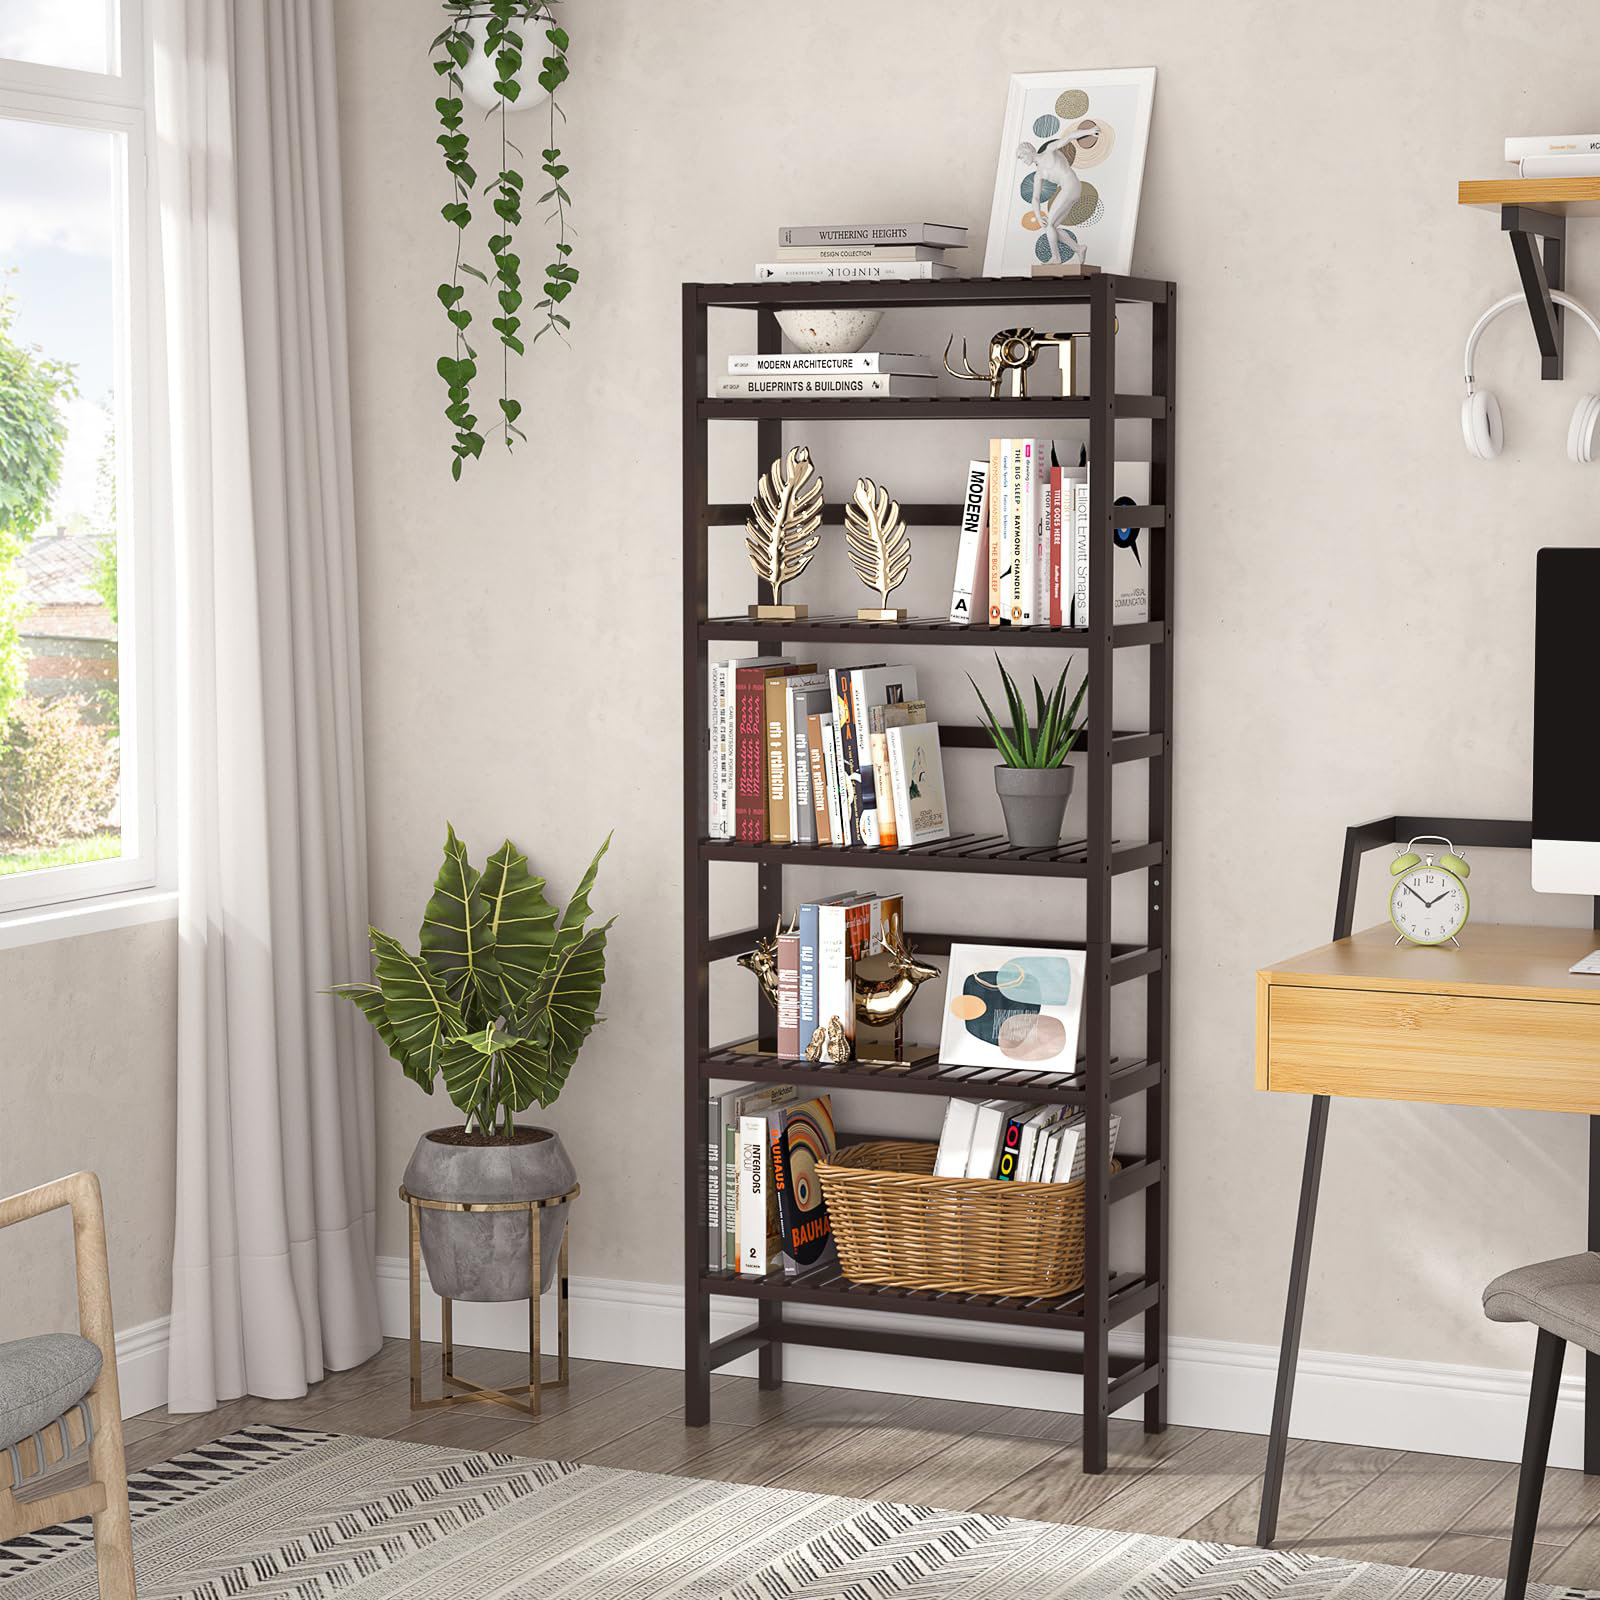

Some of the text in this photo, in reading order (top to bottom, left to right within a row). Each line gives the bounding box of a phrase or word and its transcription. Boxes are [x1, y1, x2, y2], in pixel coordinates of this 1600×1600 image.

[819, 228, 908, 240] WUTHERING HEIGHTS
[820, 250, 840, 258] DESIGN
[827, 267, 880, 277] KINFOLK
[757, 359, 853, 370] MODERN ARCHITECTURE
[748, 380, 864, 392] BLUEPRINTS & BUILDINGS
[991, 455, 999, 494] RAYMOND
[964, 470, 986, 533] MODERN
[991, 495, 999, 535] CHANDLER
[1053, 489, 1061, 545] TITLE GOES HERE
[1076, 488, 1088, 609] Elliott Erwitt Snaps
[954, 598, 968, 612] A
[769, 721, 784, 738] arts
[795, 733, 807, 749] arts
[810, 748, 821, 762] arts
[770, 750, 785, 800] architecture
[796, 760, 809, 805] architecture
[813, 771, 825, 811] architecture
[1413, 878, 1421, 887] 11
[1425, 874, 1435, 884] 12
[1441, 879, 1446, 887] 1
[1403, 887, 1411, 896] 10
[1450, 889, 1457, 898] 2
[1397, 901, 1403, 909] 9
[1454, 903, 1460, 912] 3
[1400, 914, 1406, 922] 8
[1449, 916, 1454, 925] 4
[1411, 924, 1417, 933] 7
[1424, 928, 1430, 936] 6
[1440, 925, 1446, 934] 5
[743, 1143, 752, 1172] NOW!
[769, 1129, 785, 1190] BAUHAUS
[752, 1144, 761, 1194] INTERIORS
[750, 1247, 757, 1258] 2
